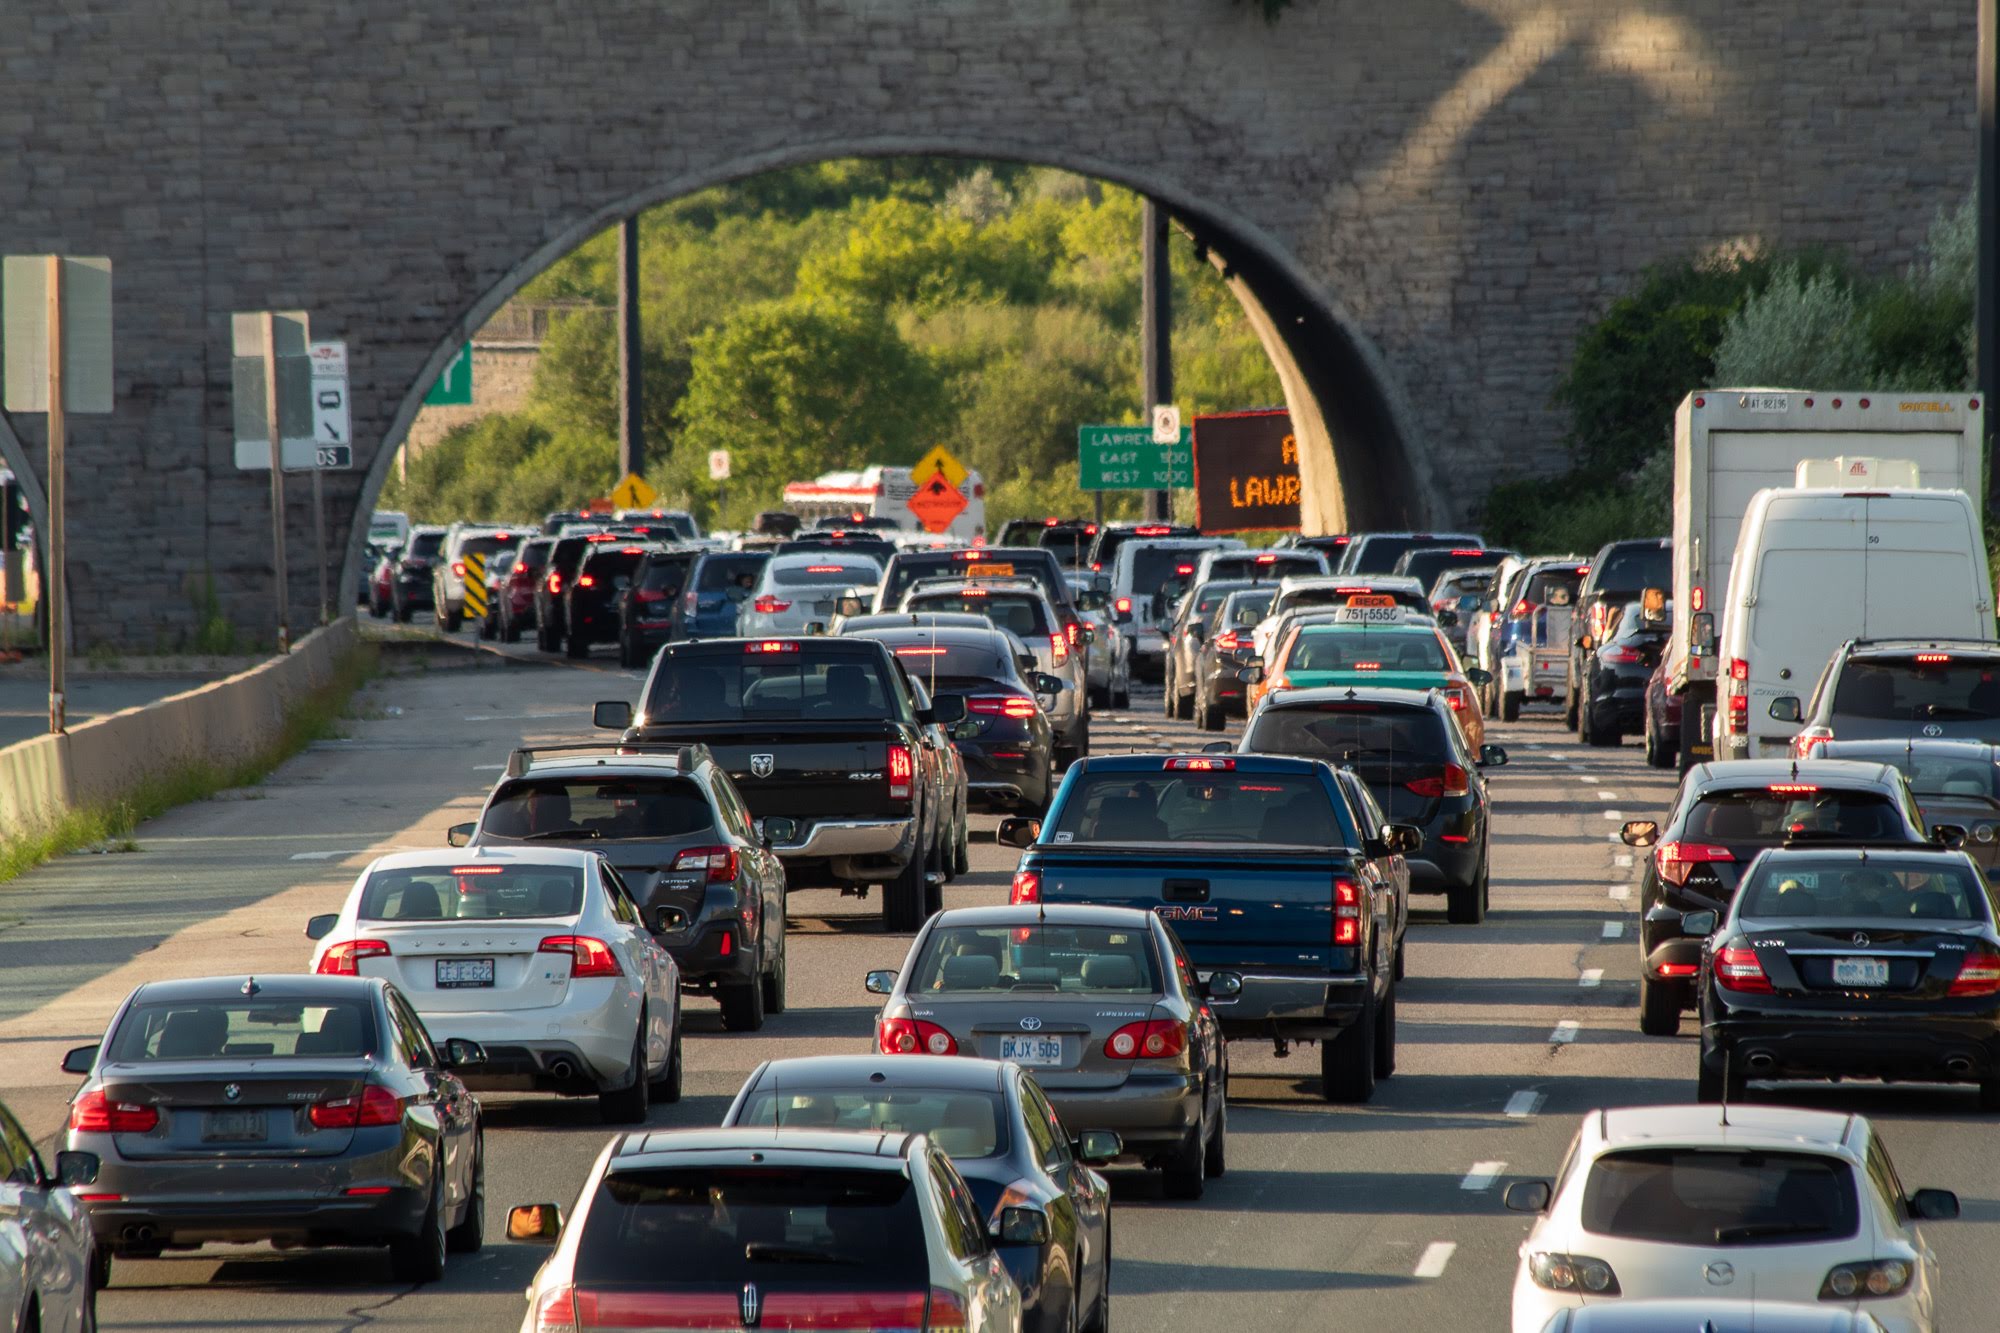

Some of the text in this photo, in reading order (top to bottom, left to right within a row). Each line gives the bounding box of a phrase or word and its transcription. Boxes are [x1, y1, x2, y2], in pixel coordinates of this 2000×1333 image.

[1091, 433, 1153, 446] LAWREN
[1101, 470, 1140, 483] WEST
[1868, 535, 1880, 544] 50
[1355, 597, 1387, 605] BECK
[1153, 905, 1217, 921] GMC
